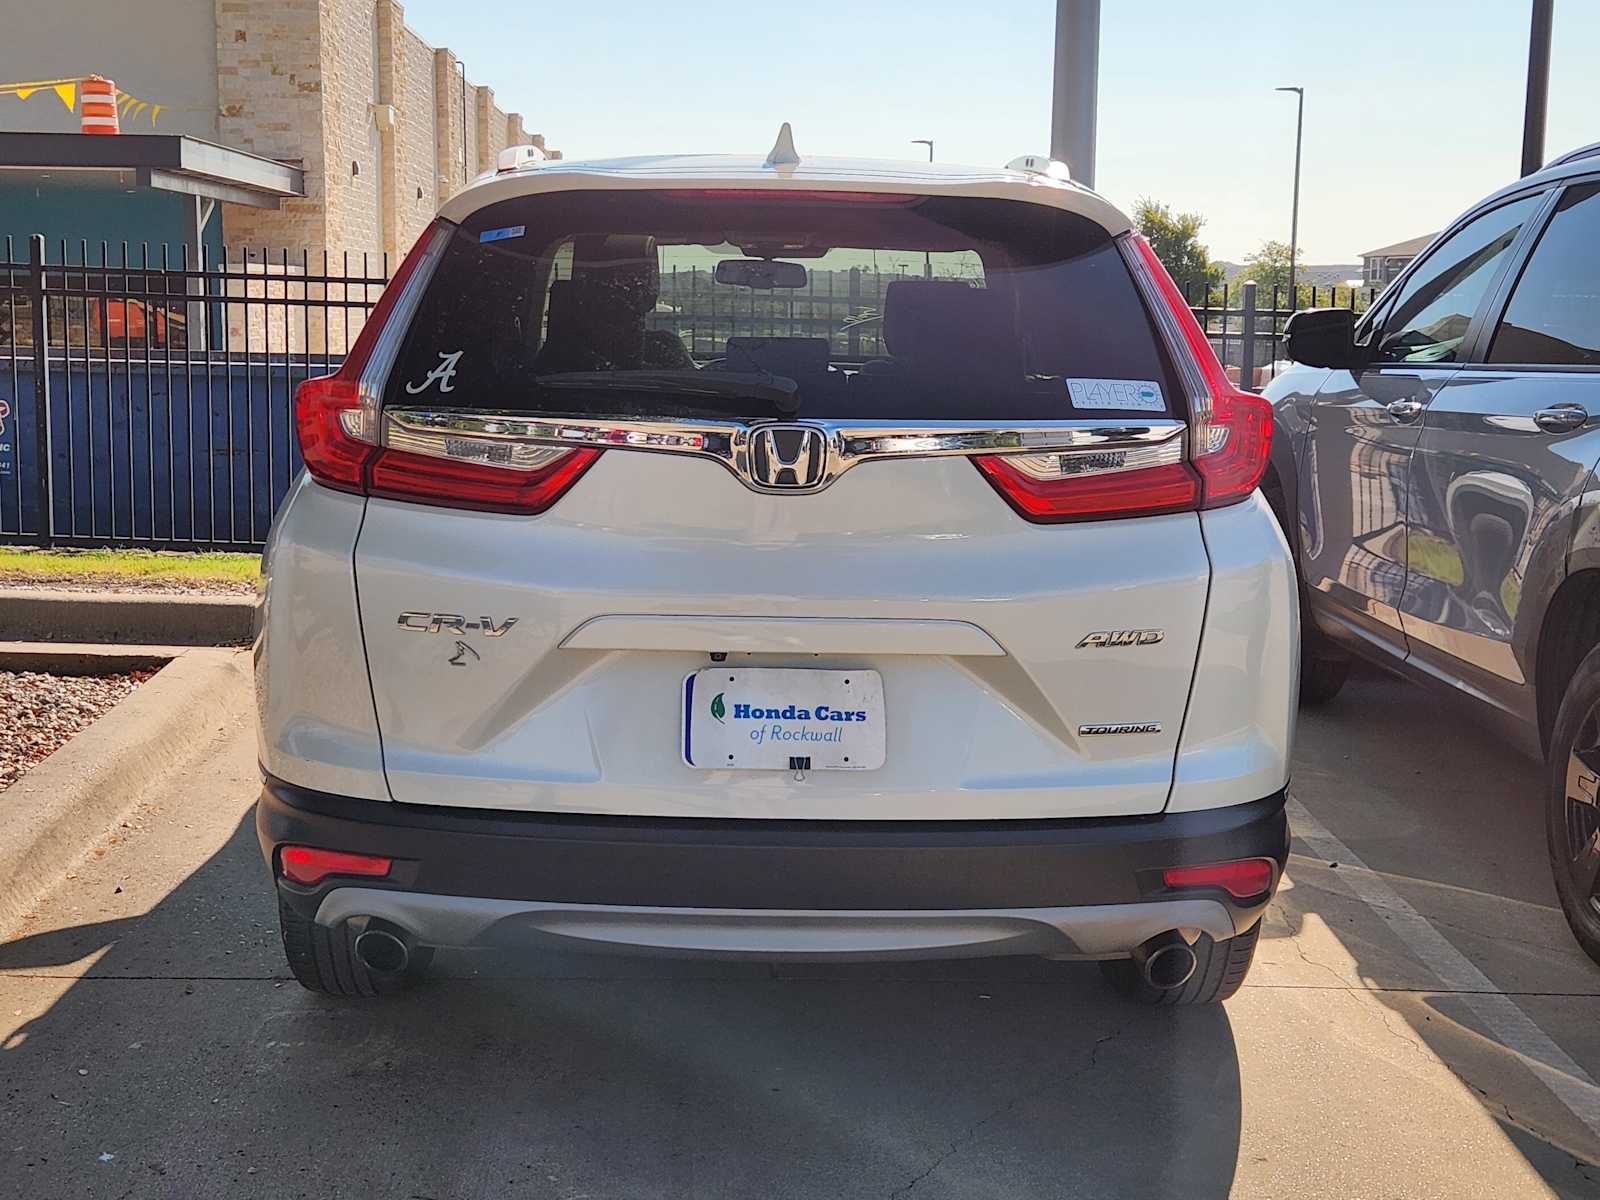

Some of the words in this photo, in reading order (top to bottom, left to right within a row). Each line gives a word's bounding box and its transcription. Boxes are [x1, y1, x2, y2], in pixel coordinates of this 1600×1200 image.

[405, 350, 464, 394] A
[397, 611, 520, 638] CR-V
[1074, 628, 1166, 649] AWD
[733, 703, 811, 721] Honda
[814, 705, 867, 722] Cars
[749, 723, 768, 745] of
[770, 724, 844, 743] Rockwall
[1083, 724, 1160, 736] TOURING
